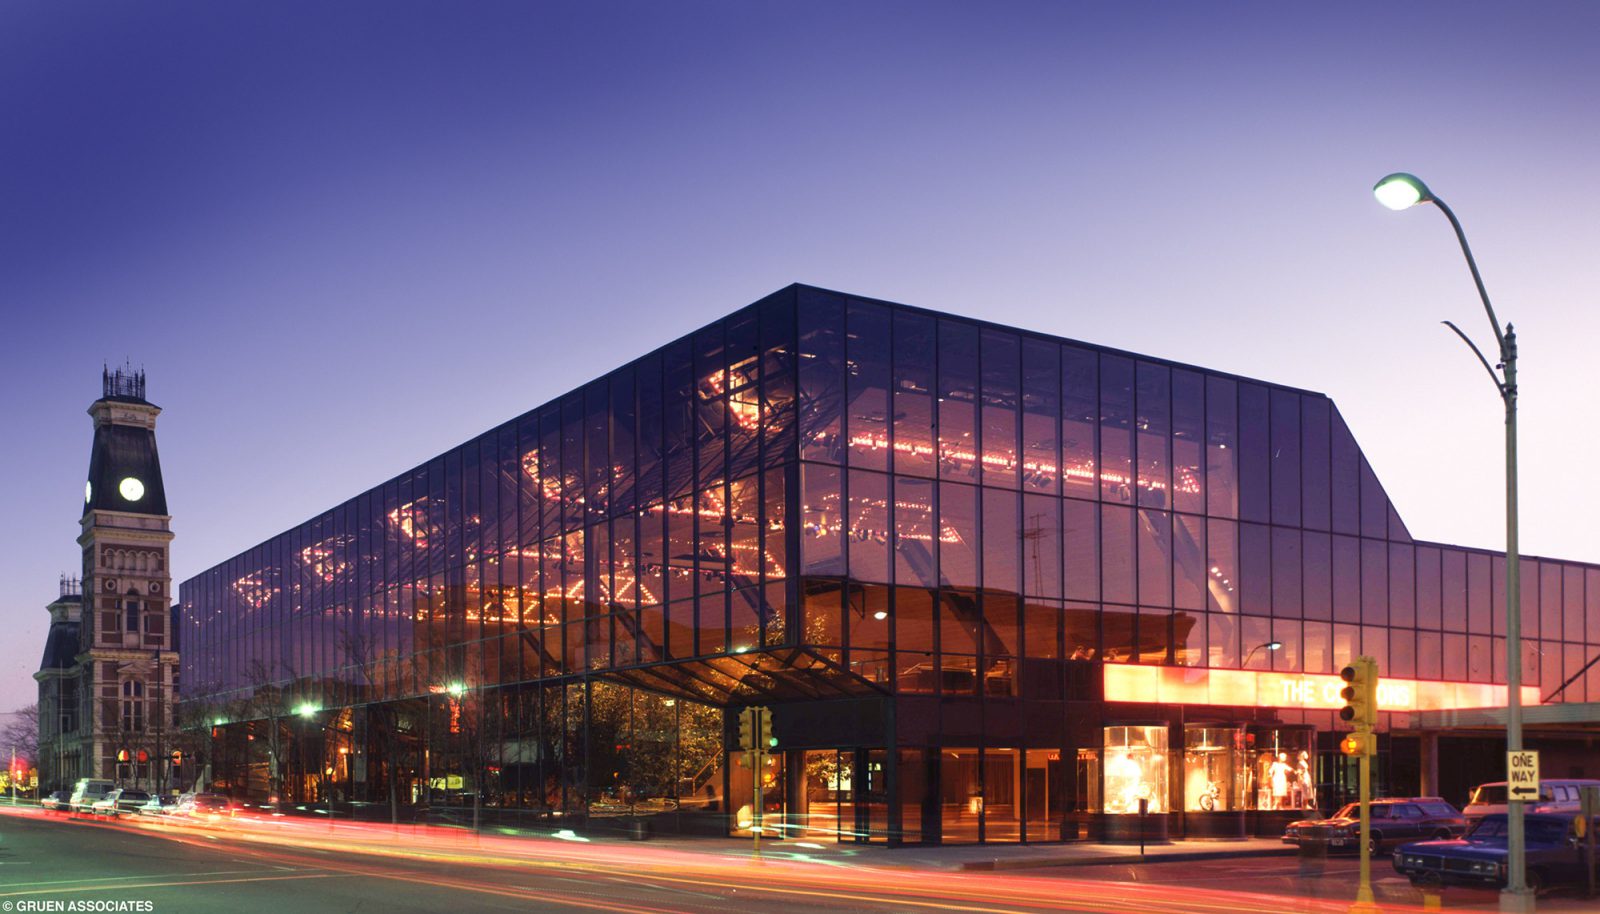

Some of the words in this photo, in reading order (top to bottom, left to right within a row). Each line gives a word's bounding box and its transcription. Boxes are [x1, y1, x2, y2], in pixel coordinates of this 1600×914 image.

[1280, 680, 1314, 703] THE
[1323, 682, 1409, 706] COONS
[1512, 755, 1534, 767] ONE
[1511, 771, 1535, 782] WAY
